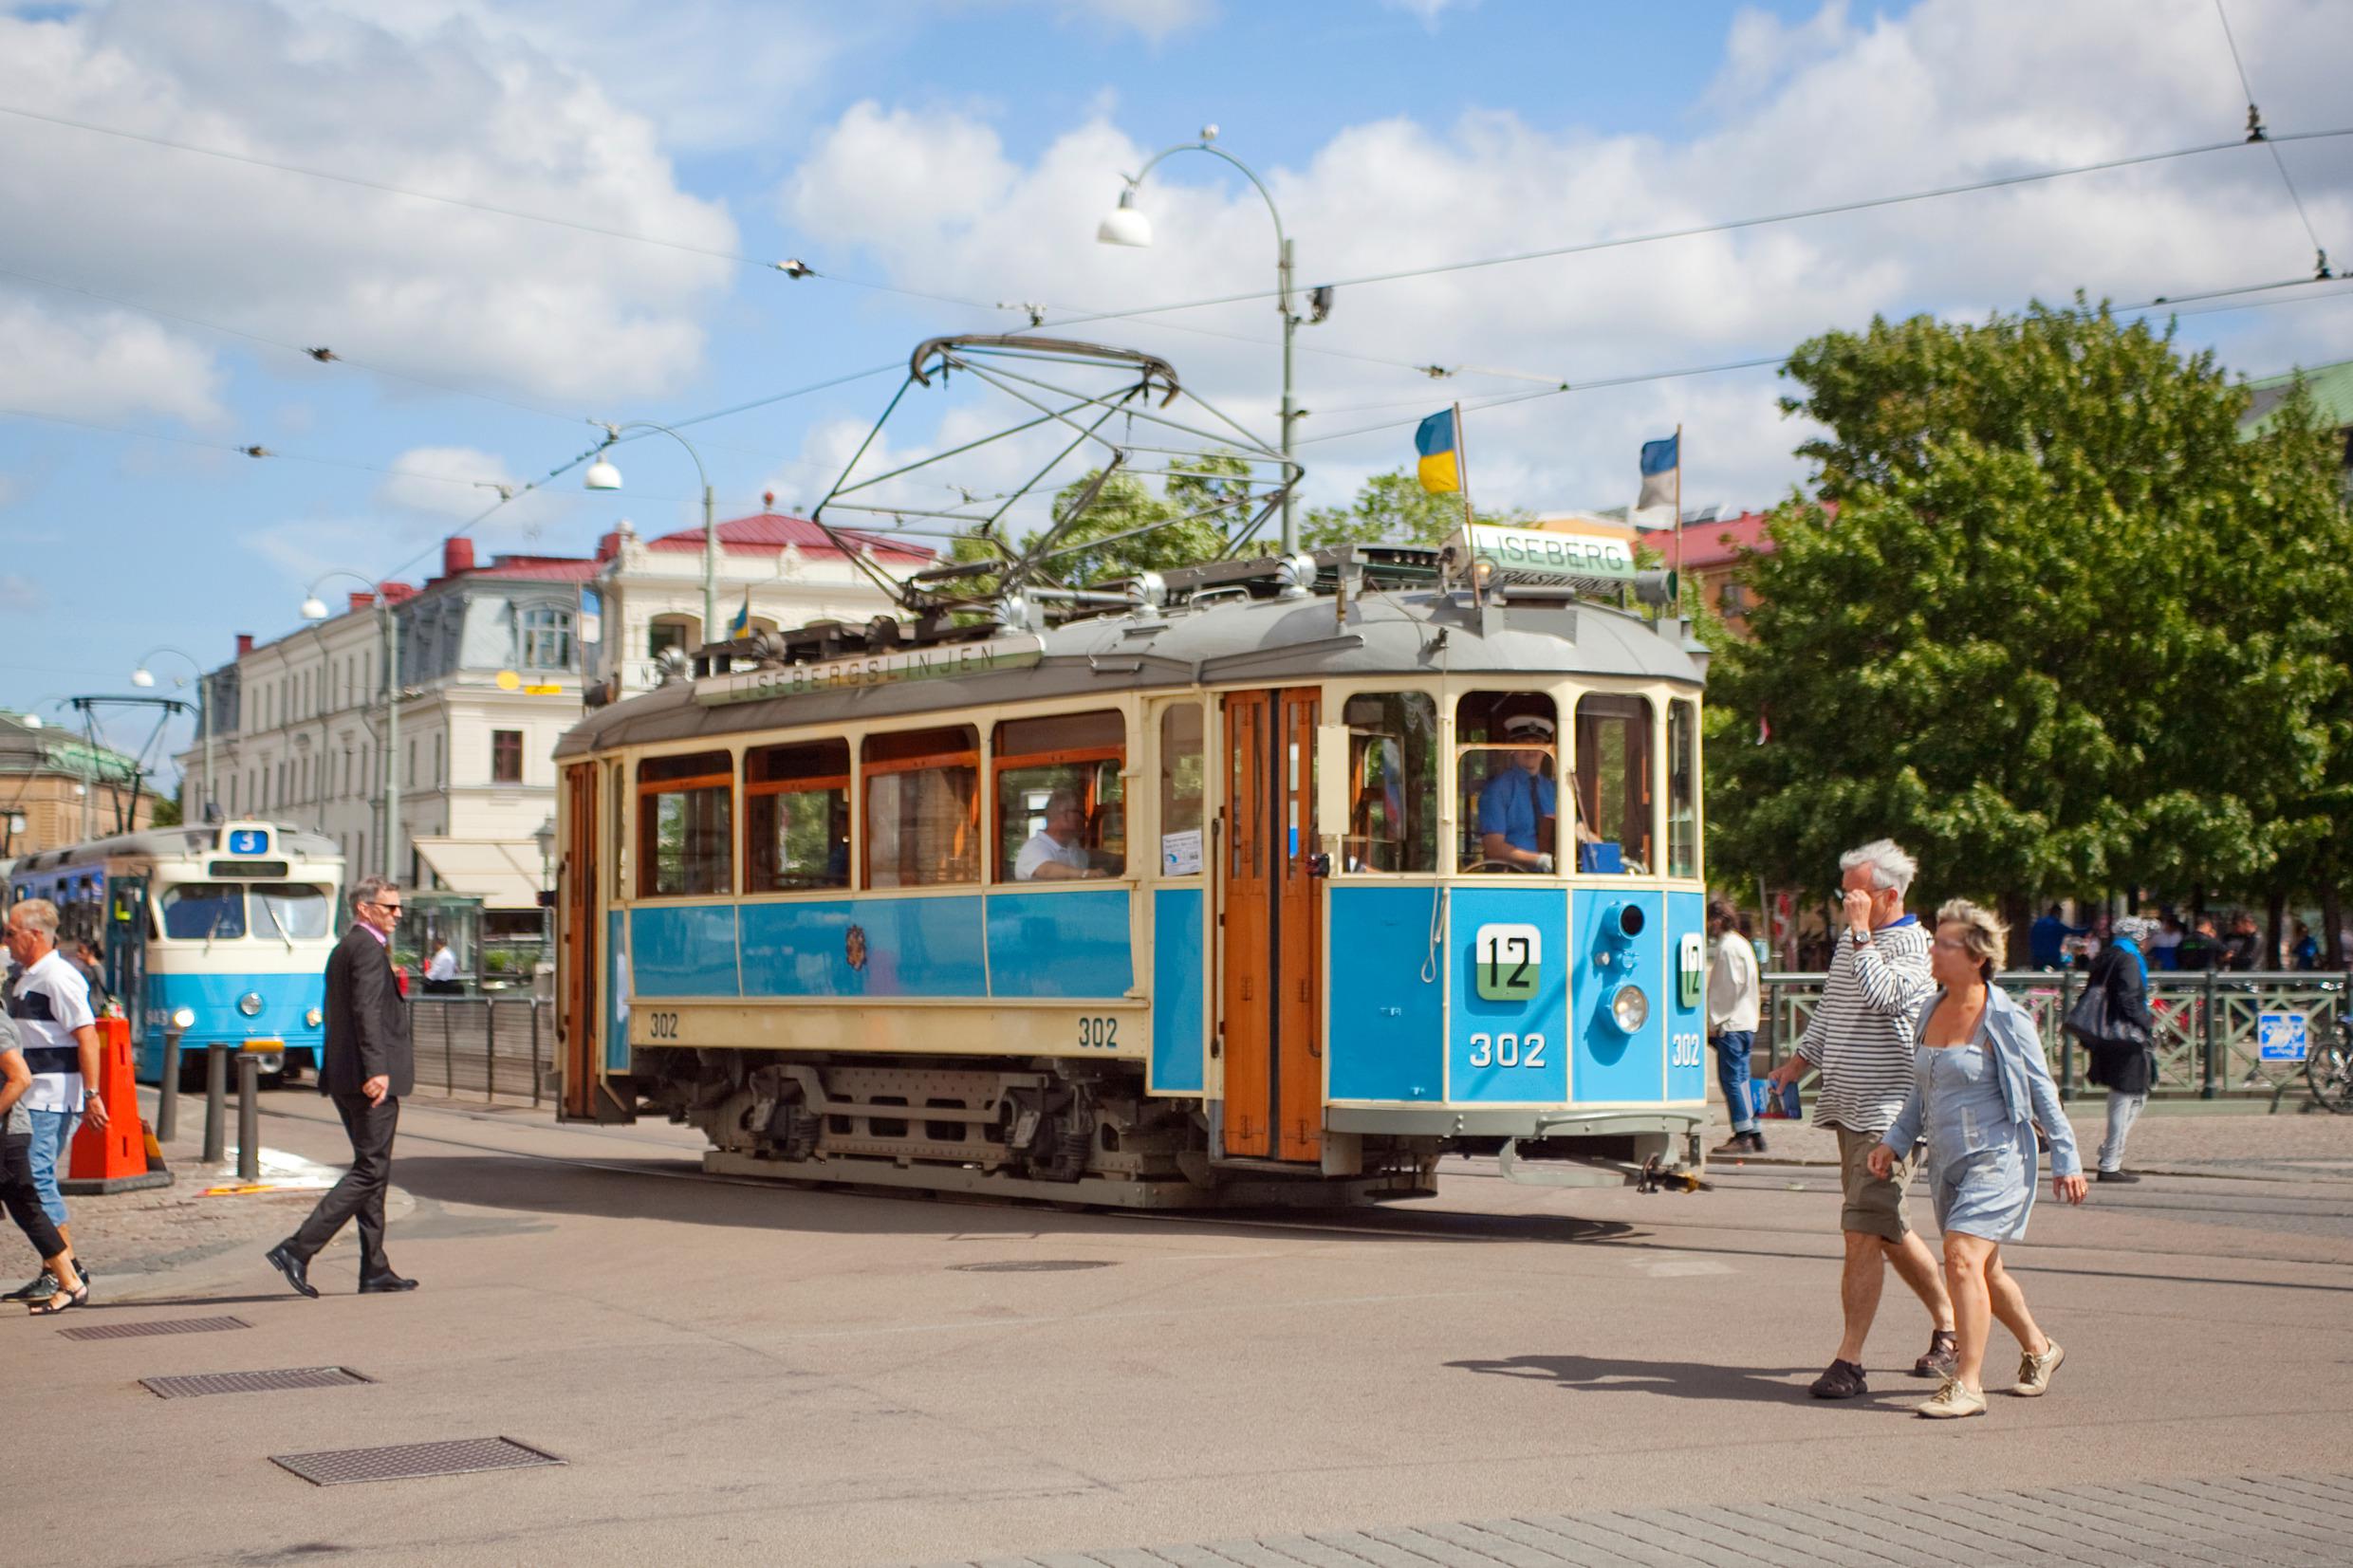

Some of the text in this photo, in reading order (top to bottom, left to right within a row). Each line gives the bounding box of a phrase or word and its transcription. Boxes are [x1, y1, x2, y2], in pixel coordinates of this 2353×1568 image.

[1476, 534, 1622, 570] LISEBERG
[728, 645, 993, 699] LISEBERGSLINJEN
[239, 832, 255, 851] 3
[1488, 937, 1529, 987] 12
[1686, 946, 1699, 994] 12
[651, 1013, 677, 1038] 302
[1079, 1017, 1117, 1047] 302
[1470, 1033, 1546, 1067] 302
[1673, 1034, 1699, 1065] 302
